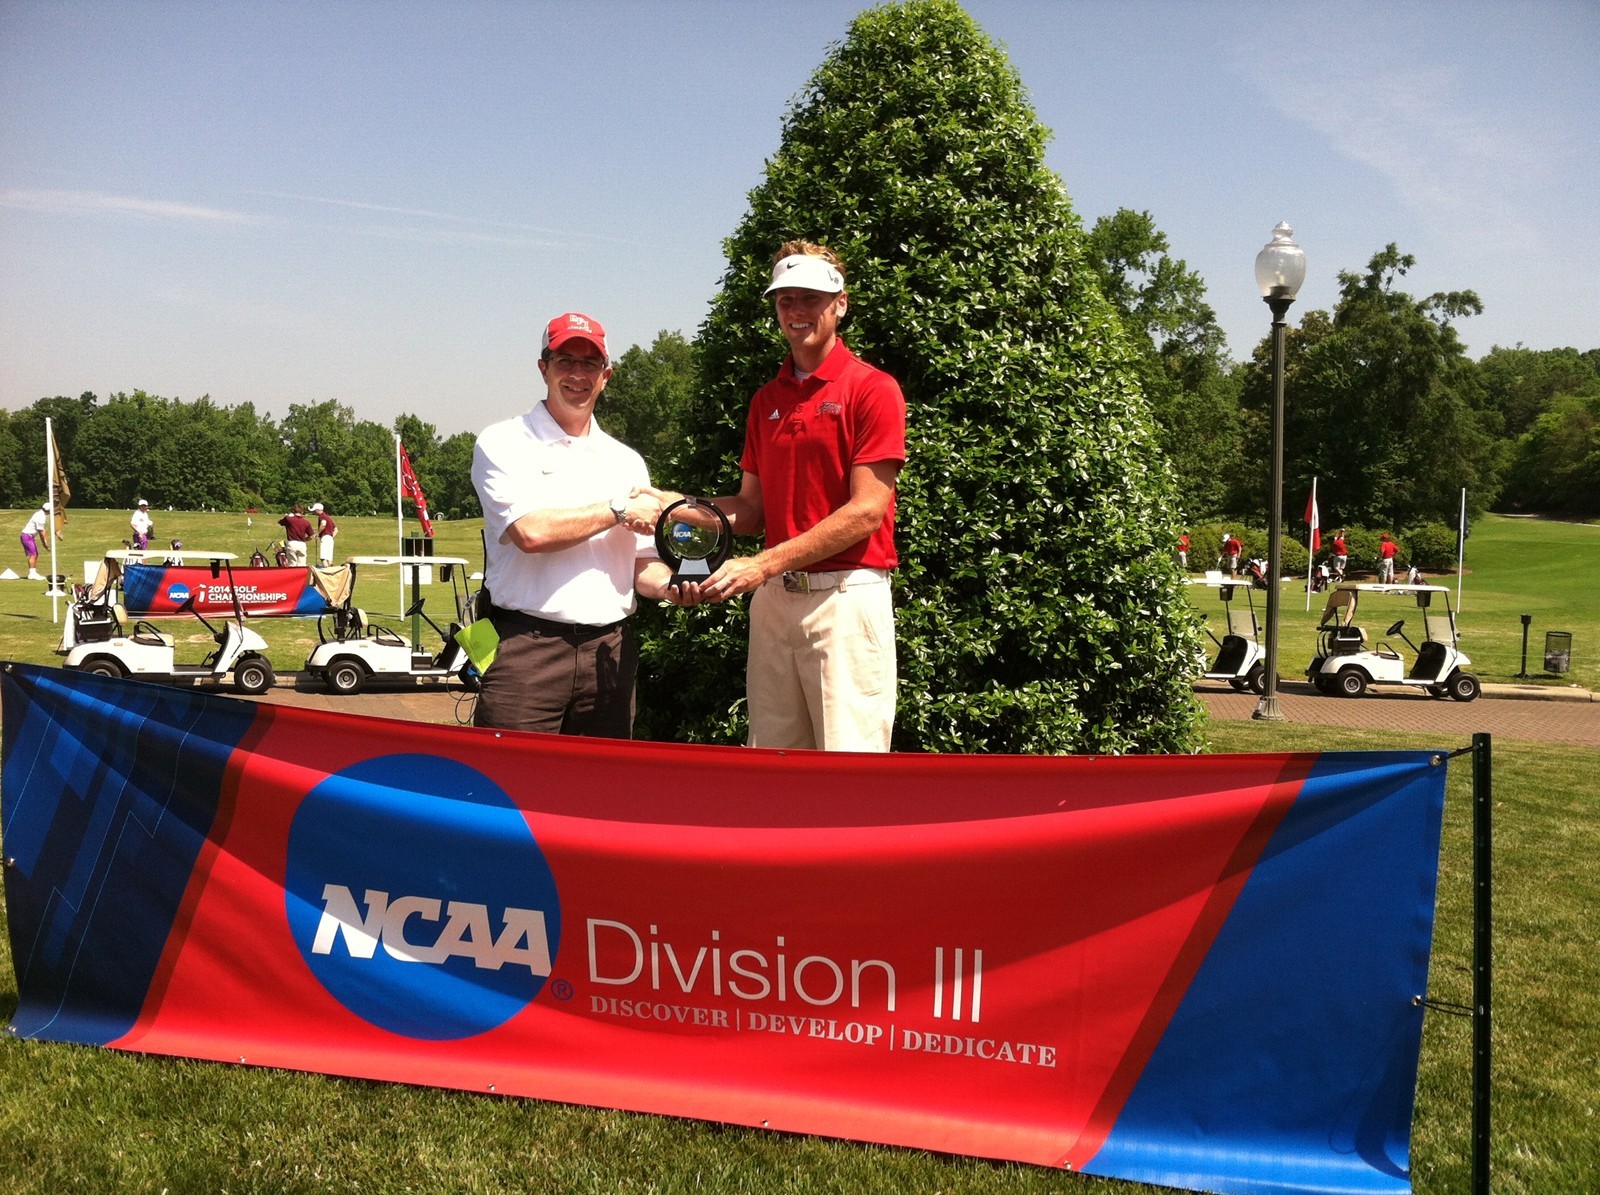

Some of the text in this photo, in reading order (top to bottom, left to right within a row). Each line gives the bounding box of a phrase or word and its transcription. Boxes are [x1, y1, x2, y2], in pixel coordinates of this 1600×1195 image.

[208, 585, 257, 593] 2014 GOLF
[311, 883, 552, 978] NCAA
[586, 917, 983, 1023] Division III
[590, 995, 1057, 1068] DISCOVER DEVELOP DEDICATE
